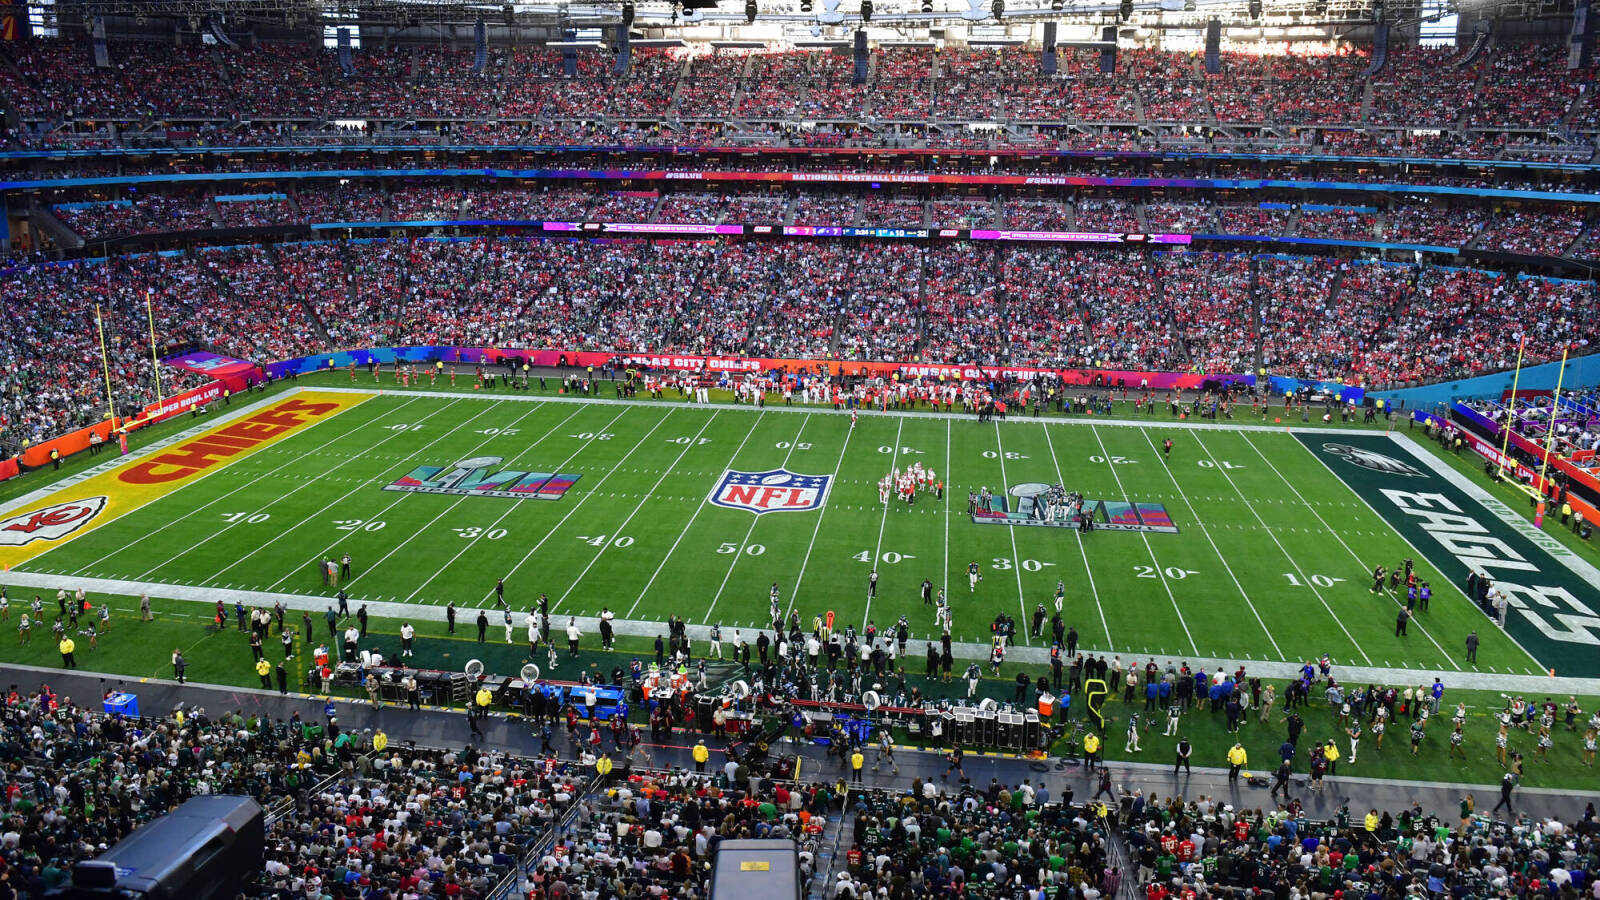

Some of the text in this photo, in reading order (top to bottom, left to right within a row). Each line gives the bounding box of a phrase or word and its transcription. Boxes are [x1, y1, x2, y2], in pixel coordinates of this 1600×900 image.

[842, 174, 890, 182] FOOTBALL
[891, 175, 929, 183] LEAGUE
[673, 358, 705, 367] CITY
[180, 393, 203, 407] BOWL
[117, 399, 341, 485] CHIEFS
[775, 441, 813, 450] 50
[1476, 442, 1498, 461] SUPER
[400, 486, 546, 499] SUPER BOWL
[721, 485, 811, 509] NFL
[225, 511, 271, 524] 10
[336, 519, 387, 532] 20
[1480, 499, 1573, 557] END RACISM
[460, 526, 508, 540] 30
[584, 534, 635, 548] 40
[716, 542, 766, 556] 50
[852, 550, 902, 564] 40
[991, 558, 1043, 572] 30
[1379, 487, 1600, 646] EAGLES
[1133, 565, 1187, 580] 20
[1282, 572, 1334, 588] 10
[58, 711, 66, 720] 12
[867, 835, 878, 844] 92
[1206, 863, 1214, 872] 12
